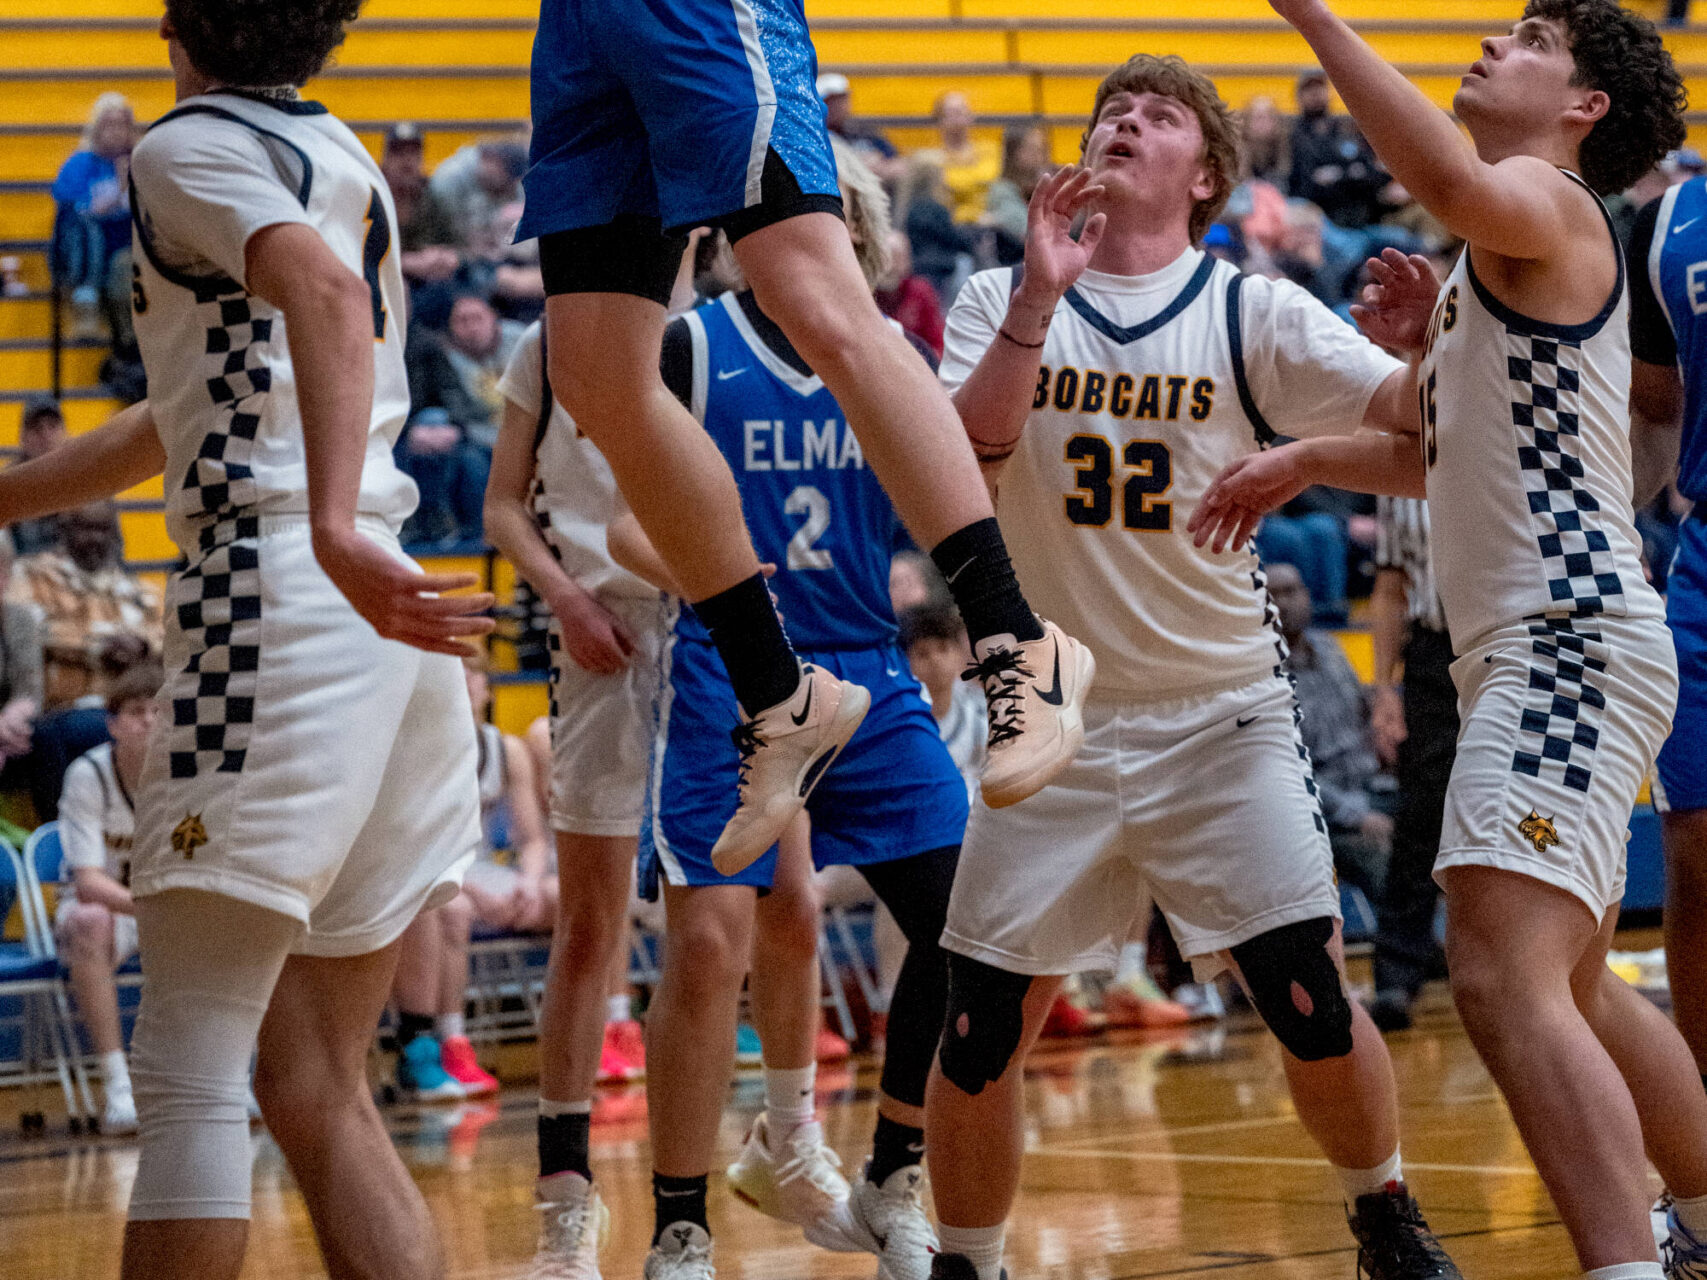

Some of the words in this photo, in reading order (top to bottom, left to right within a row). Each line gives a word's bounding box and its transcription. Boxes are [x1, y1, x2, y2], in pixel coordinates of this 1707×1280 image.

[1031, 364, 1216, 422] BOBCATS
[743, 418, 864, 471] ELMA
[1063, 432, 1174, 534] 32
[784, 485, 834, 570] 2
